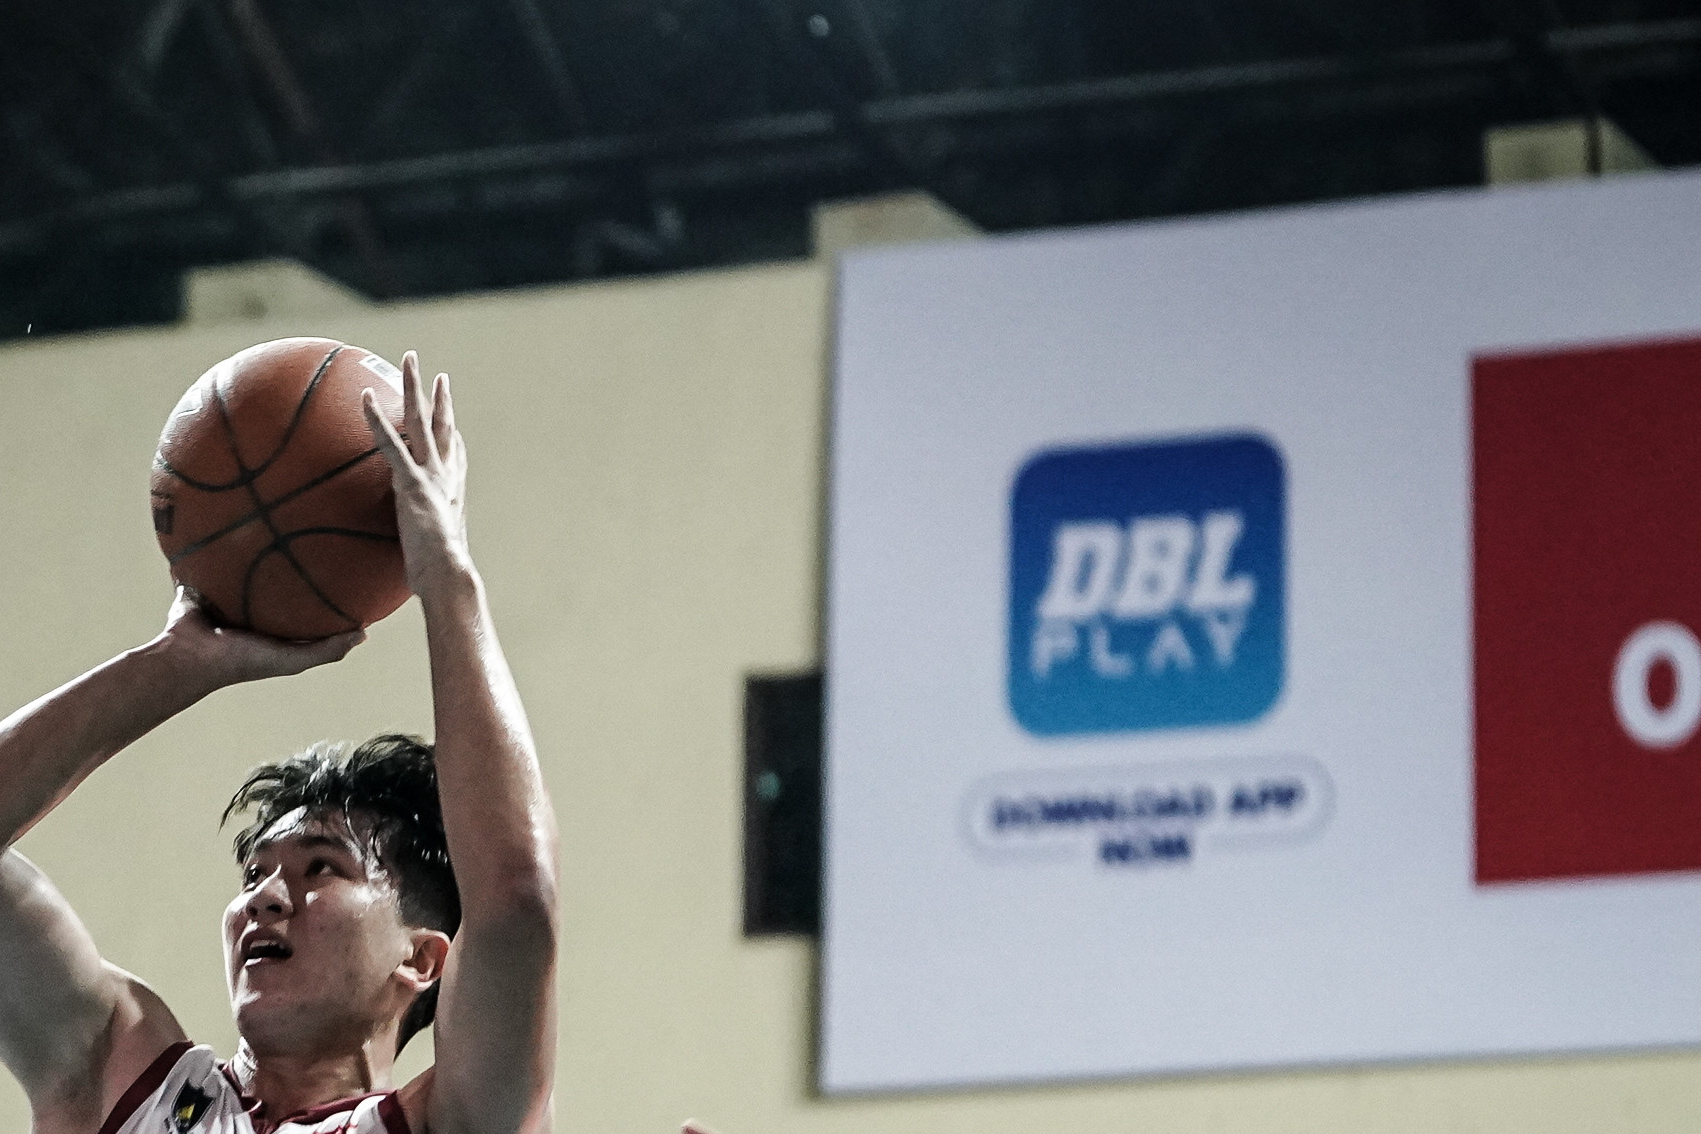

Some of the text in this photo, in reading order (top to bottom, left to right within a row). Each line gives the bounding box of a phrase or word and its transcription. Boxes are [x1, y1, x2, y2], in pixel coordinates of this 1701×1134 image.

[1037, 510, 1256, 620] DBL
[1031, 608, 1248, 680] PLAY
[992, 784, 1214, 833] DOWNLOAD
[1230, 777, 1303, 815] APP
[1101, 836, 1192, 868] NOW
